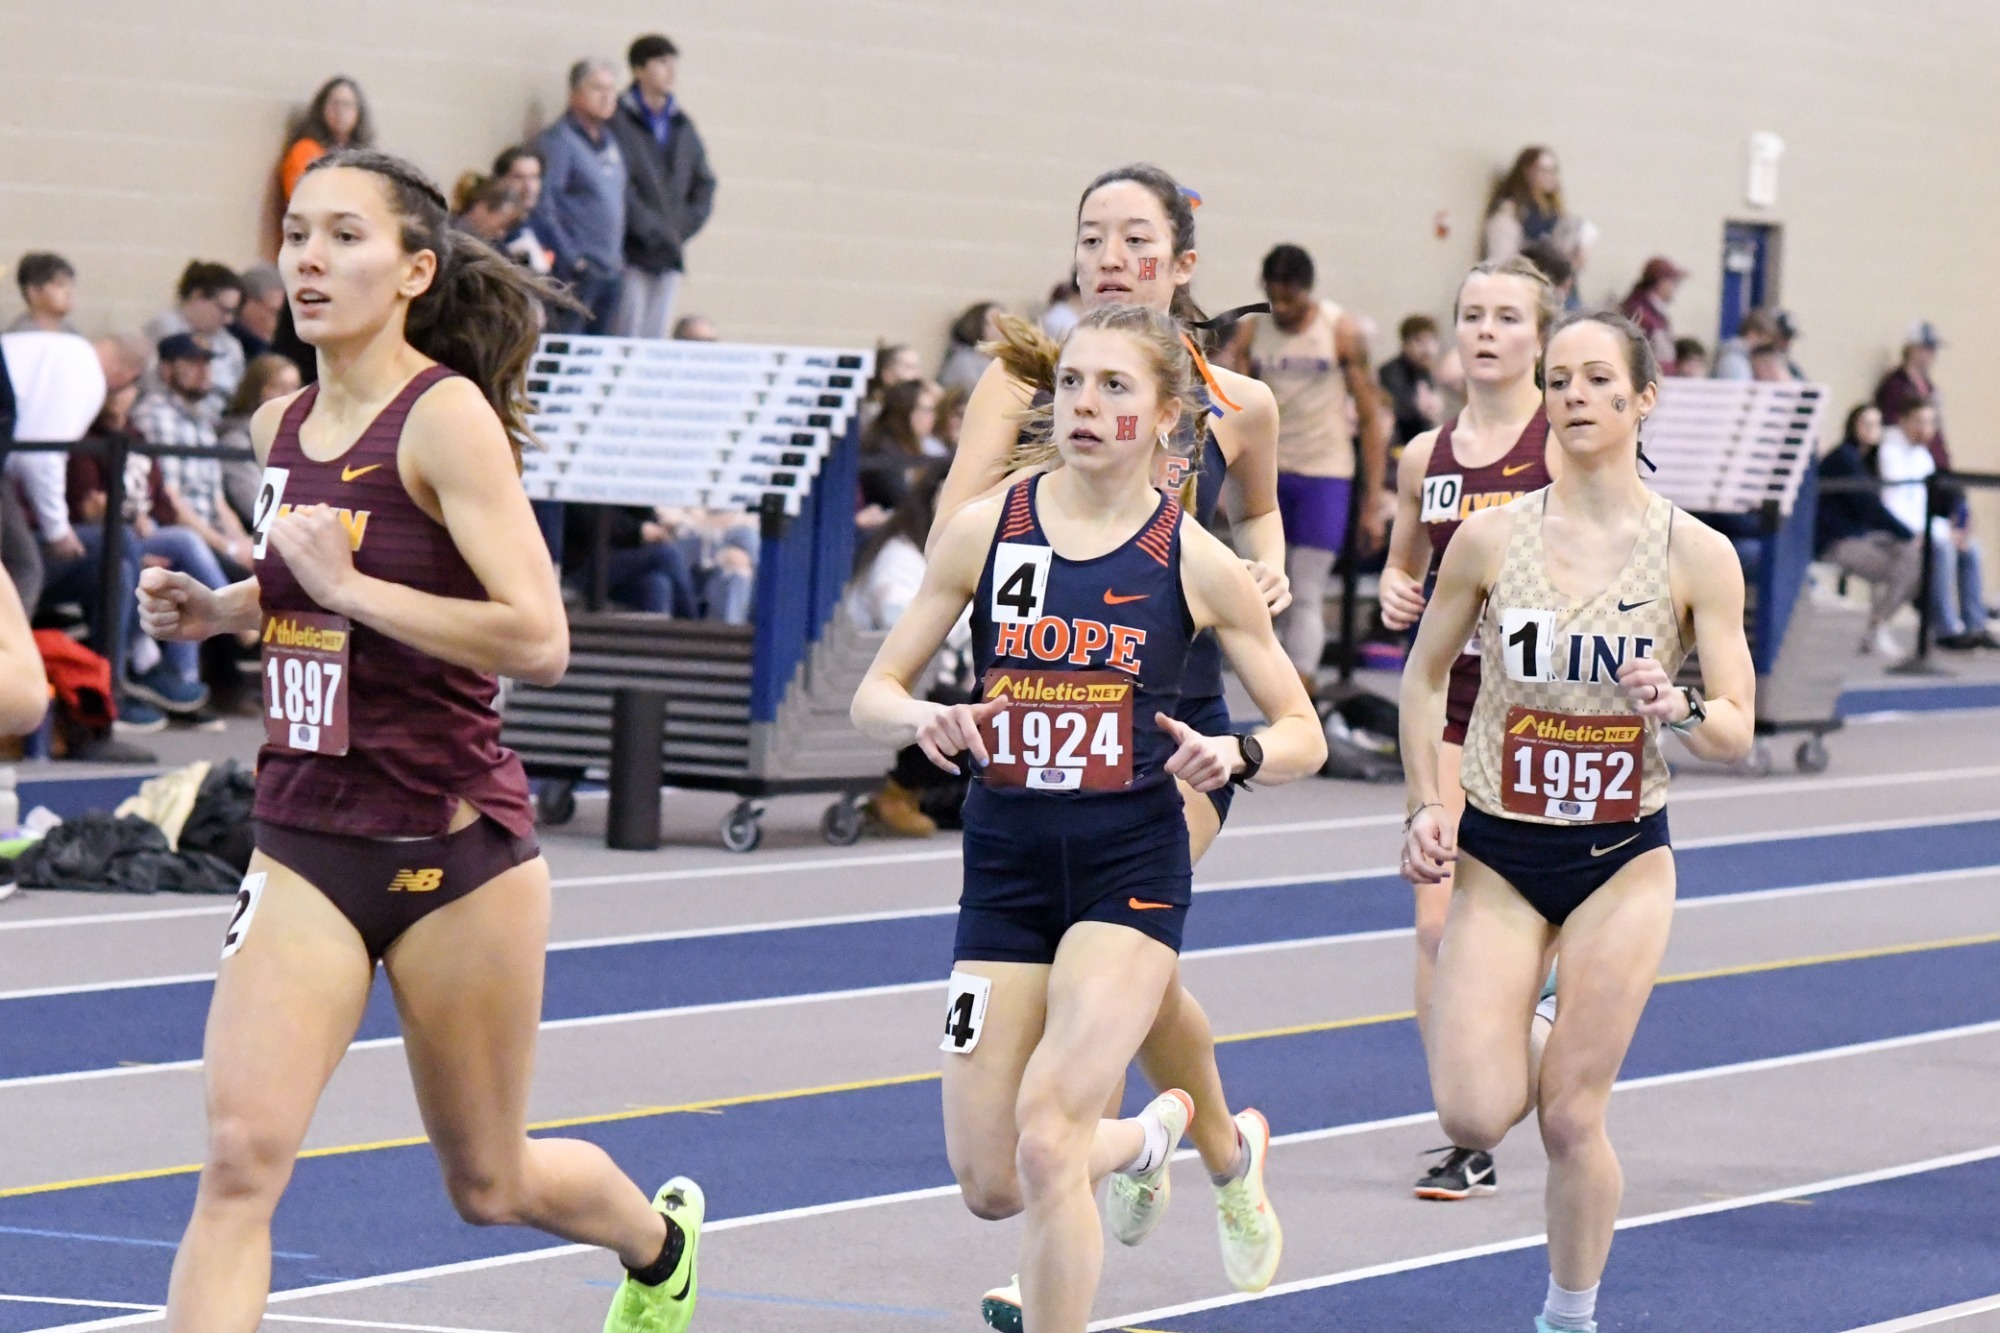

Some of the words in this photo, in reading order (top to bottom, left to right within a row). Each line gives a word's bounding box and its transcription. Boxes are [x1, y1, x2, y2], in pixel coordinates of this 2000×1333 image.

[1138, 257, 1157, 280] H
[1116, 416, 1138, 440] H
[1427, 480, 1457, 510] 10
[997, 562, 1037, 618] 4
[995, 615, 1147, 675] HOPE
[1509, 621, 1540, 677] 1
[267, 657, 342, 726] 1897
[986, 675, 1088, 701] Athletic
[991, 710, 1123, 767] 1924
[1509, 714, 1605, 742] Athletic
[1513, 746, 1635, 800] 1952
[945, 992, 975, 1048] 4
